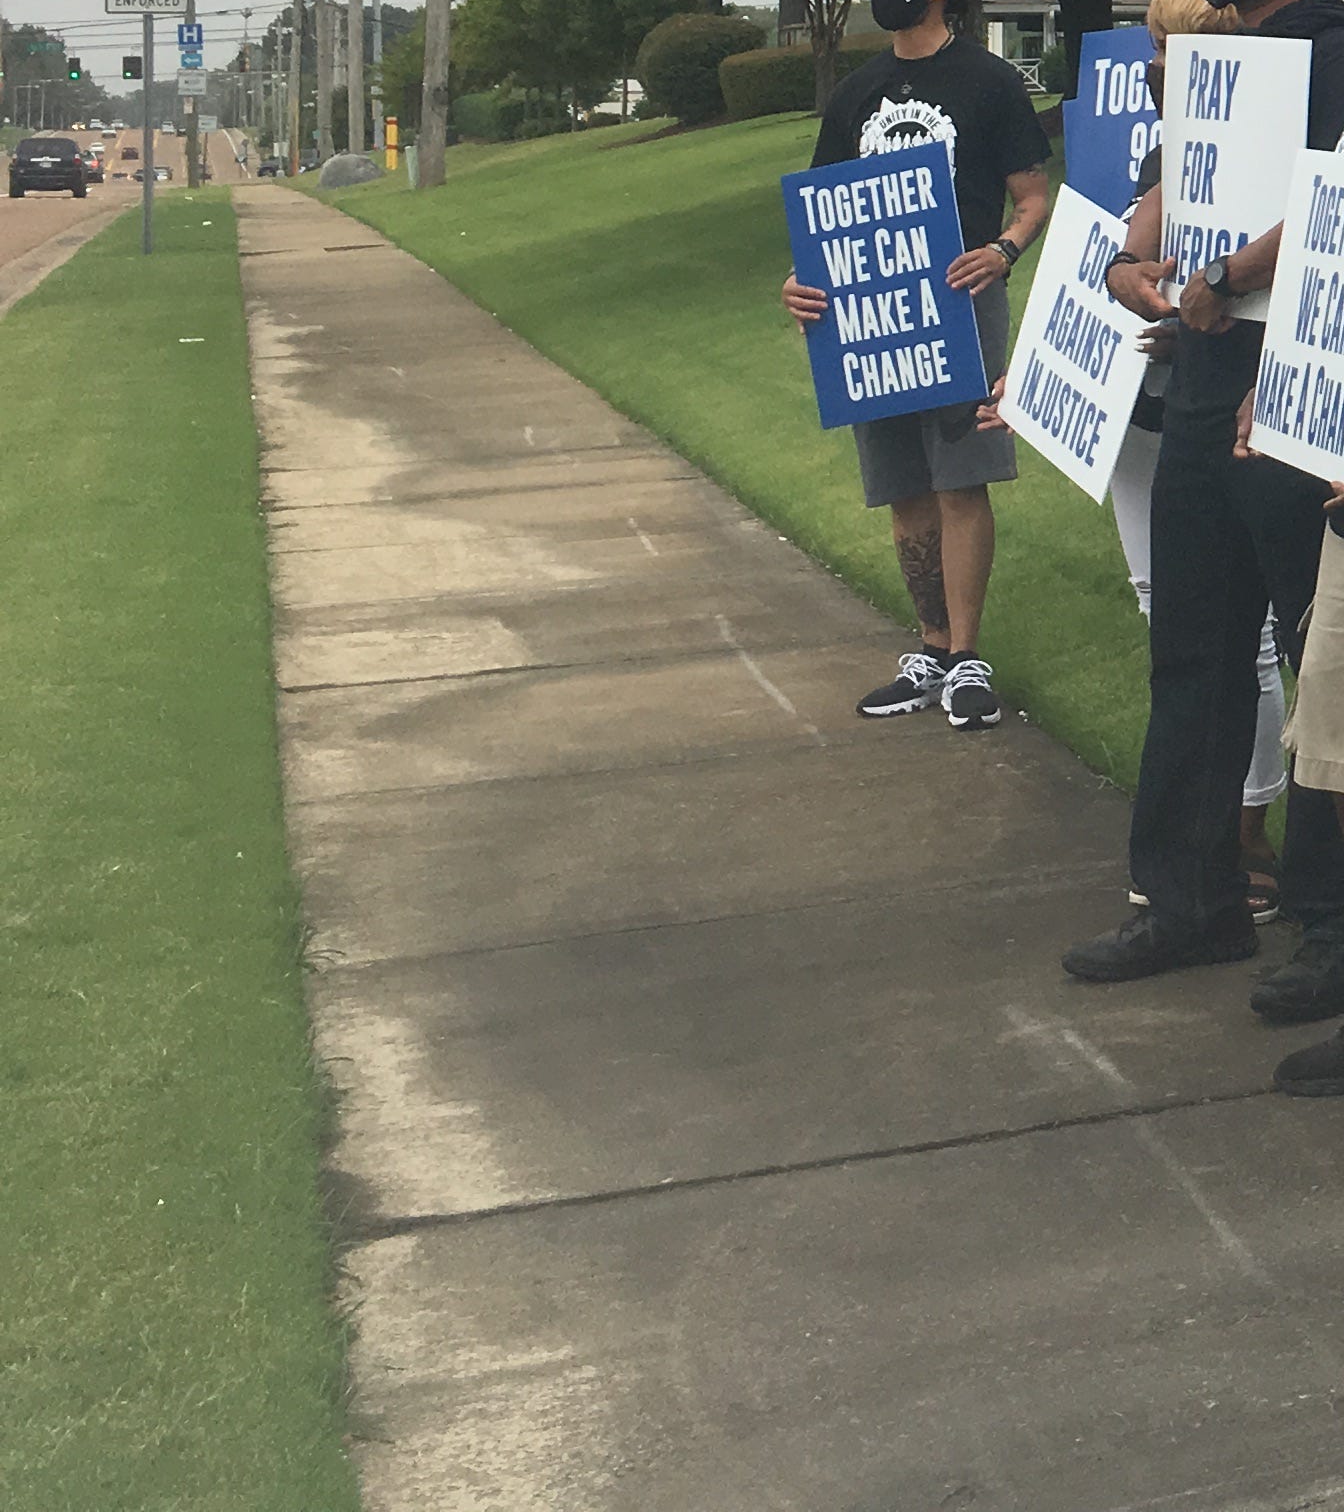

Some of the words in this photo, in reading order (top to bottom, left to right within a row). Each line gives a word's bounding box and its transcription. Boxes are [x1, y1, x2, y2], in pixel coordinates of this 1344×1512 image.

[182, 26, 198, 44] H
[879, 107, 908, 130] UNITY
[911, 107, 922, 120] IN
[922, 110, 941, 132] THE
[1185, 49, 1241, 123] PRAY
[798, 166, 938, 235] TOGETHER
[1179, 139, 1218, 205] FOR
[821, 235, 871, 288] WE
[874, 225, 932, 278] CAN
[1077, 220, 1121, 305] COP
[833, 287, 915, 345] MAKE
[919, 277, 941, 328] A
[1042, 283, 1123, 387] AGAINST
[1294, 265, 1326, 347] WE
[842, 339, 952, 402] CHANGE
[1252, 347, 1299, 436] MAKE
[1292, 361, 1312, 441] A
[1016, 347, 1108, 468] INJUSTICE
